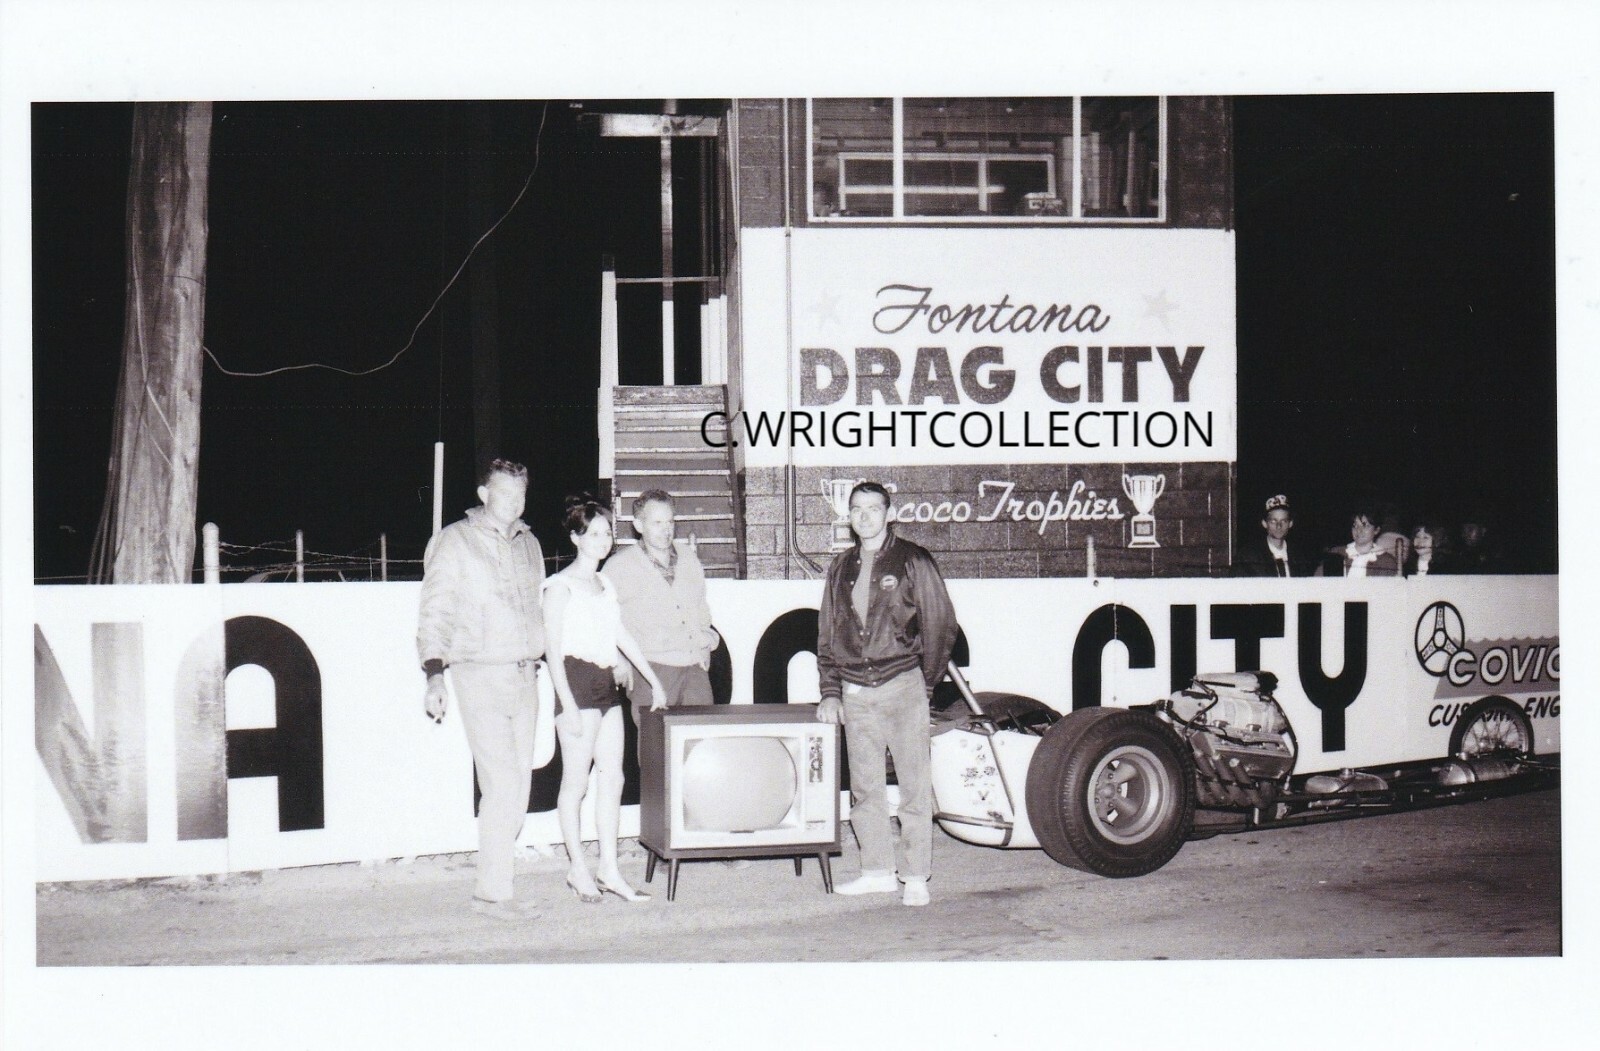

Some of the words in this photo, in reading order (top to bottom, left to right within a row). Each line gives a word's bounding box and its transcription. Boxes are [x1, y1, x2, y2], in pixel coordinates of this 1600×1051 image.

[872, 284, 1110, 334] Fontana
[800, 346, 1016, 406] DRAG
[1040, 346, 1205, 403] CITY
[976, 480, 1125, 535] Trophies
